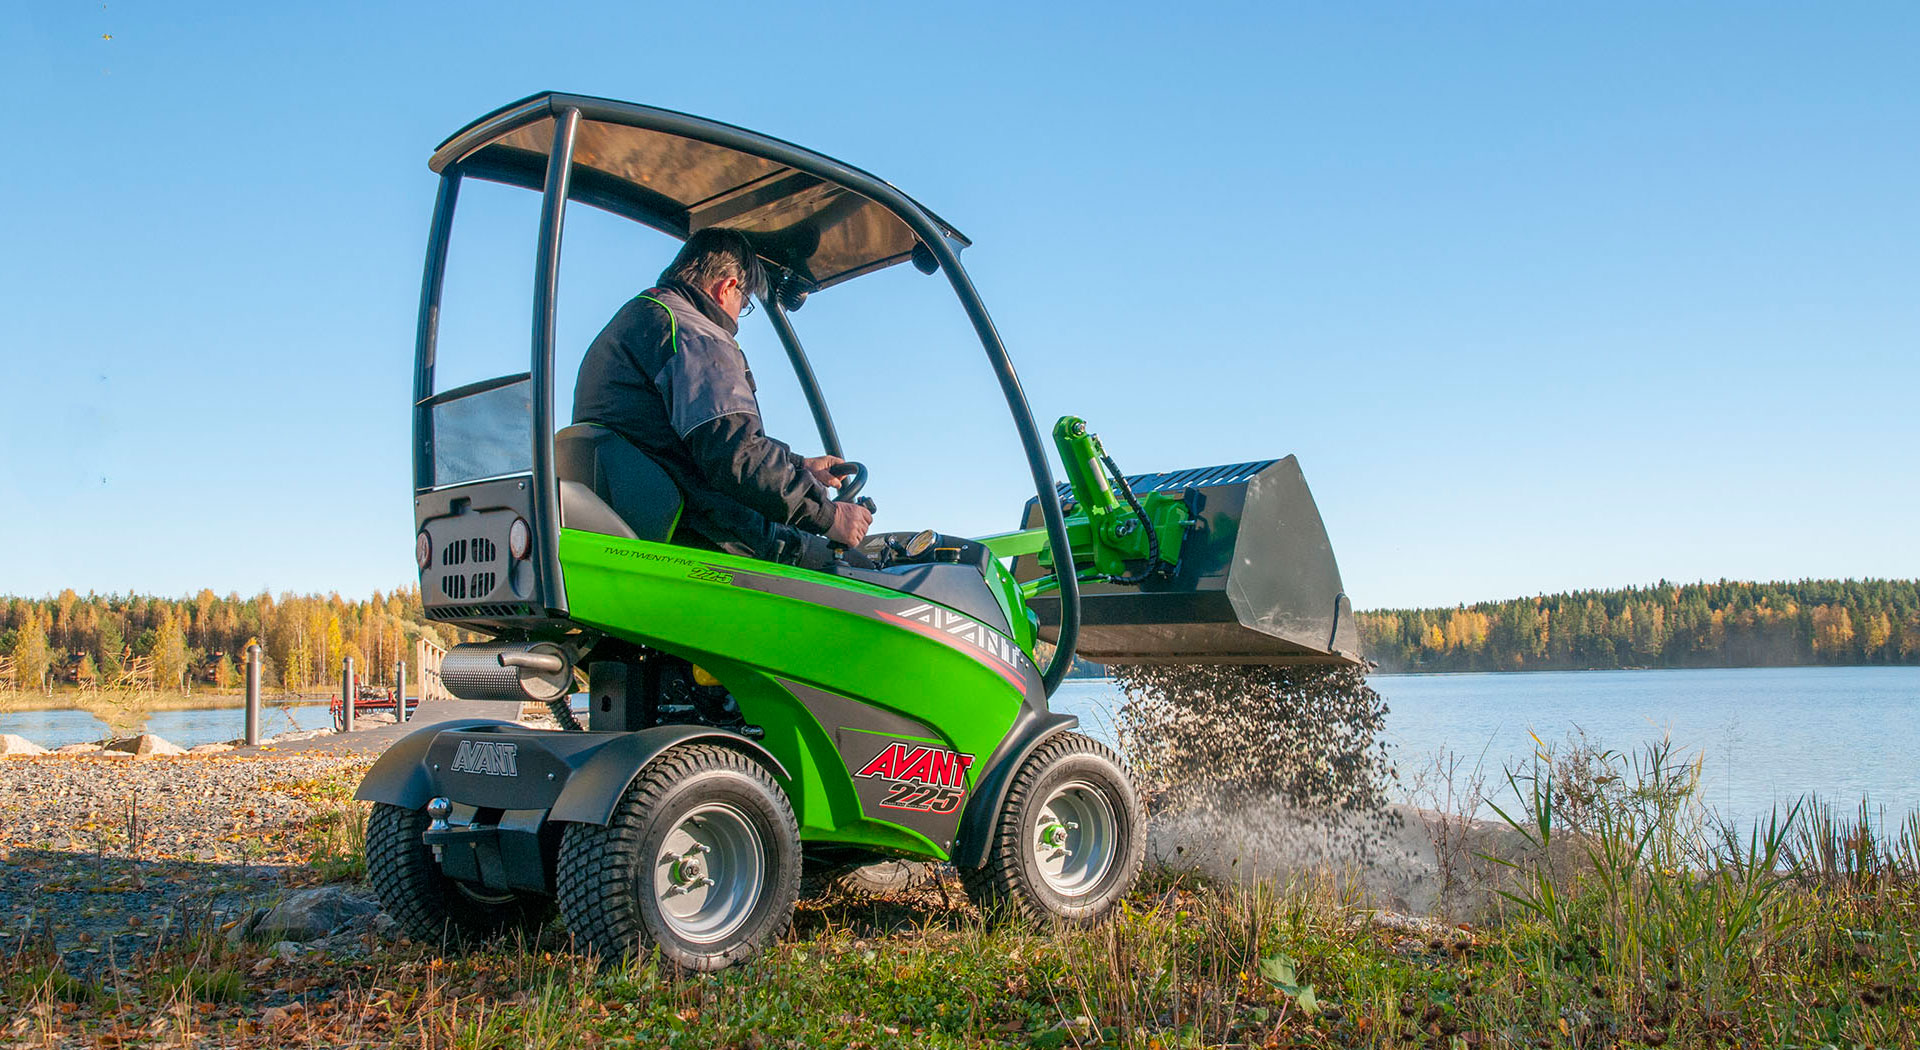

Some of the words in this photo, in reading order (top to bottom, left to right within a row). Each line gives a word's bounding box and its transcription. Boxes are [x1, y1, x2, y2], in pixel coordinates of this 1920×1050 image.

[604, 547, 629, 556] TWO
[631, 551, 672, 563] TWENTY
[673, 558, 697, 567] FIVE
[687, 567, 735, 585] 225
[450, 740, 518, 777] AVANT
[853, 741, 976, 790] AVANT
[879, 782, 966, 815] 225
